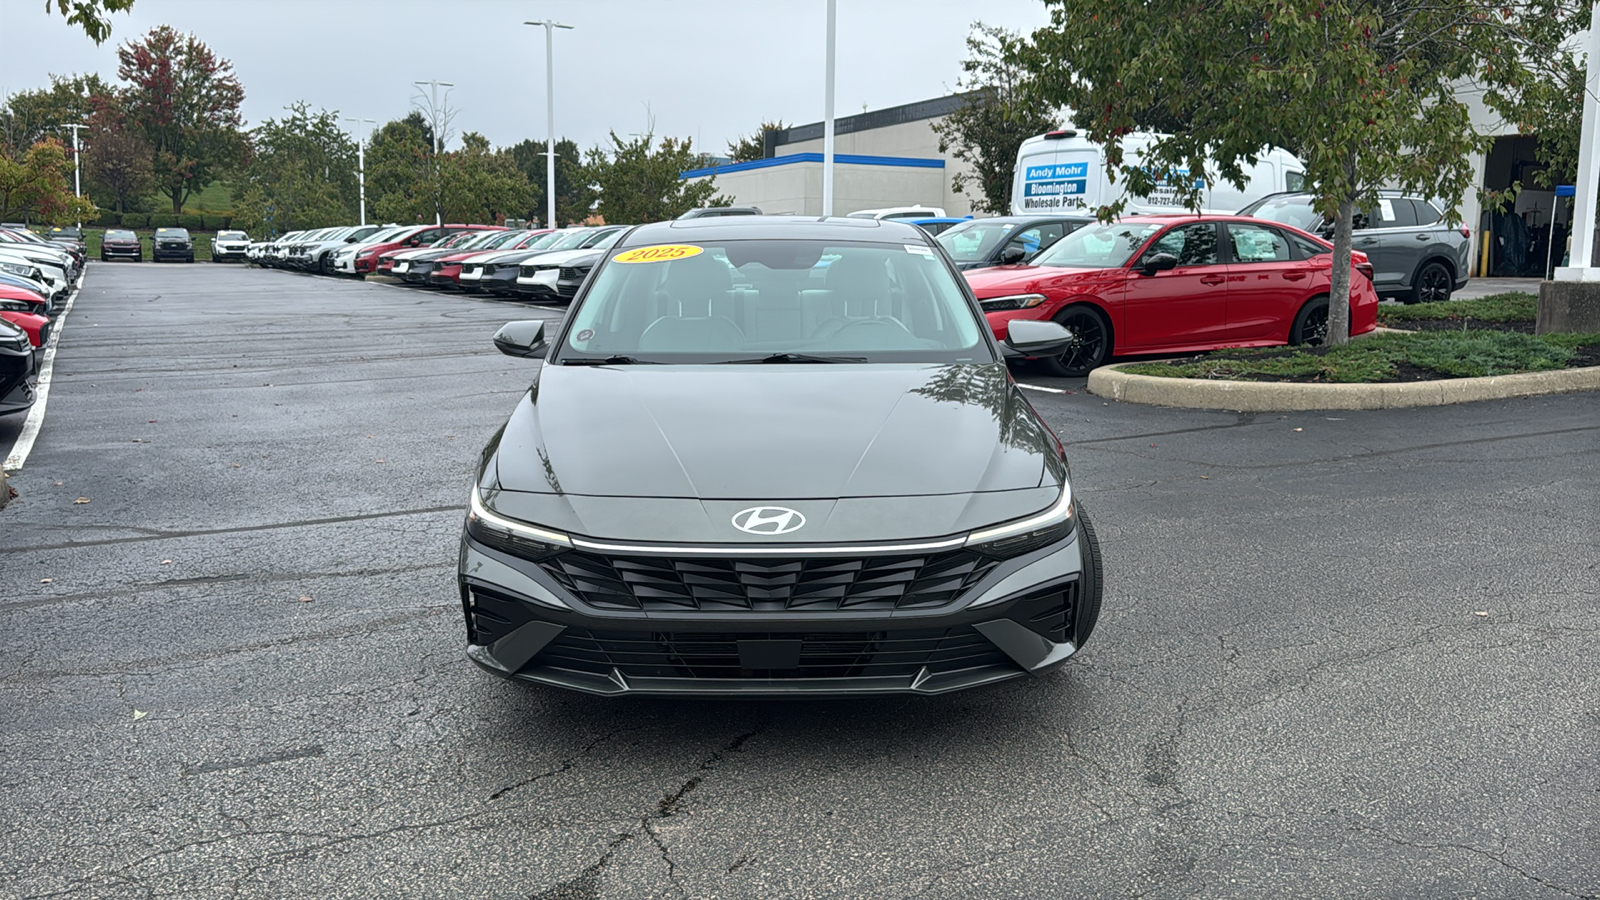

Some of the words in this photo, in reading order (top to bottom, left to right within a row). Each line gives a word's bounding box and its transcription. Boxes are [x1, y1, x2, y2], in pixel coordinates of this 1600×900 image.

[1029, 168, 1053, 178] Andy
[1055, 166, 1083, 176] Mohr
[1031, 182, 1077, 195] Bloomington
[1024, 197, 1060, 208] Wholesale
[1062, 196, 1084, 207] Parts
[1147, 196, 1184, 206] 812-727-846
[626, 247, 690, 261] 2025
